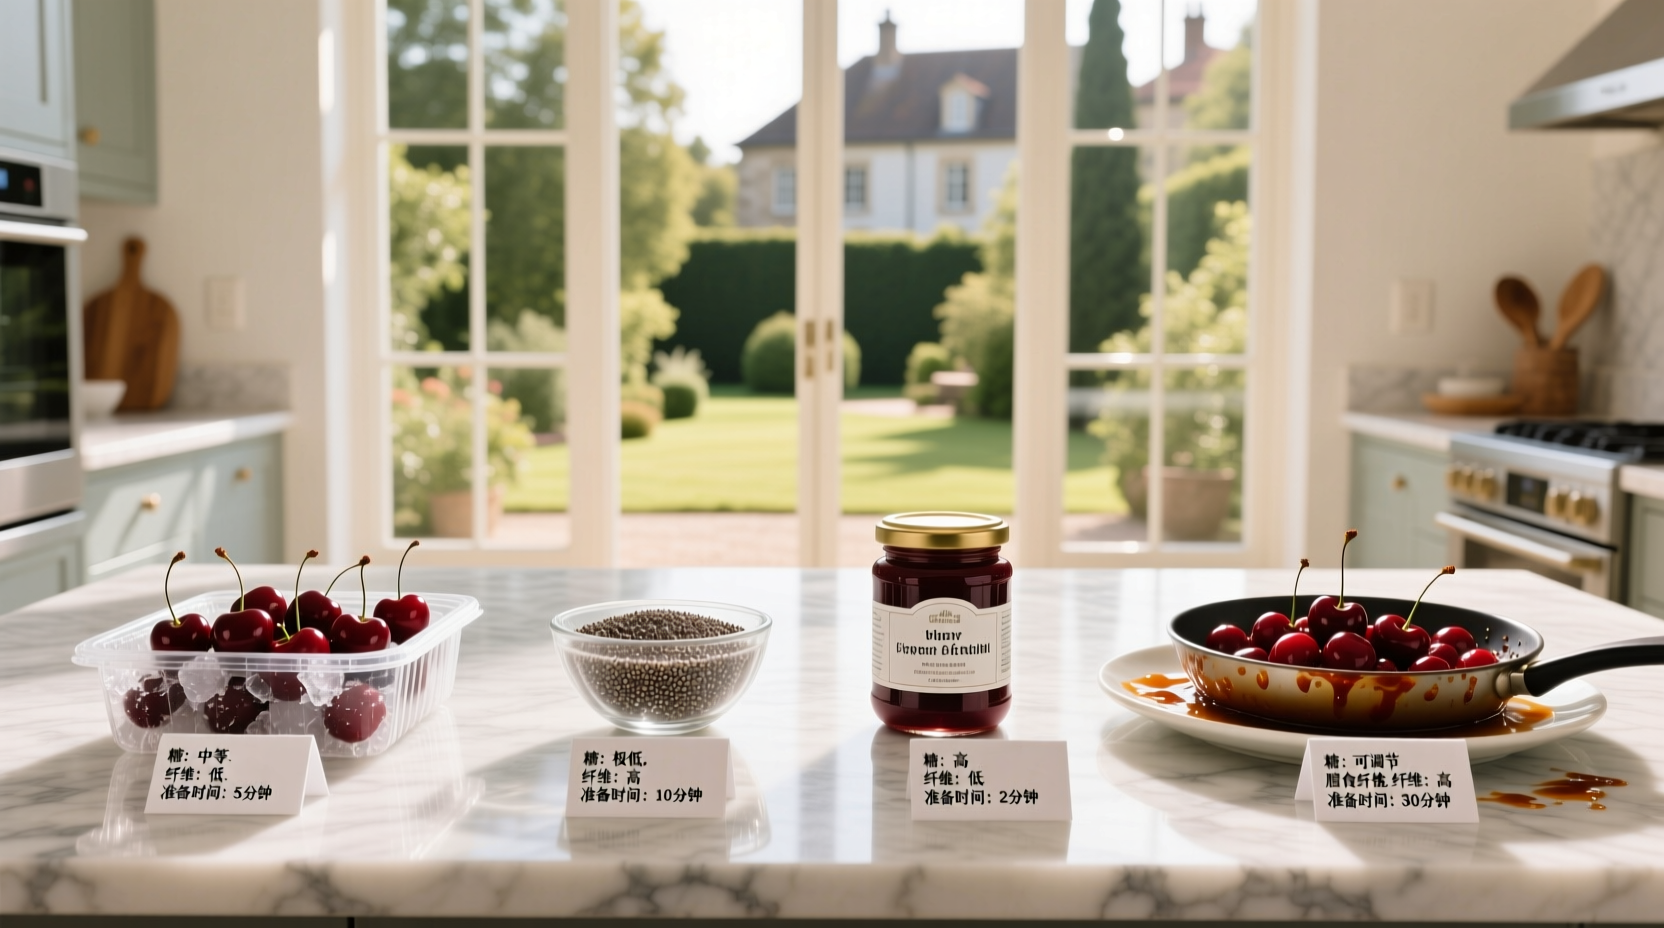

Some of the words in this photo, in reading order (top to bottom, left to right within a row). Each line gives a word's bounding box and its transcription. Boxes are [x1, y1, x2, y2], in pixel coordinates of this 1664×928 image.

[160, 784, 273, 801] 准备时间：5分钟
[580, 786, 703, 803] 准备时间：10分钟
[924, 789, 1039, 806] 准备时间：2分钟
[1327, 791, 1451, 809] 准备时间：30分钟
